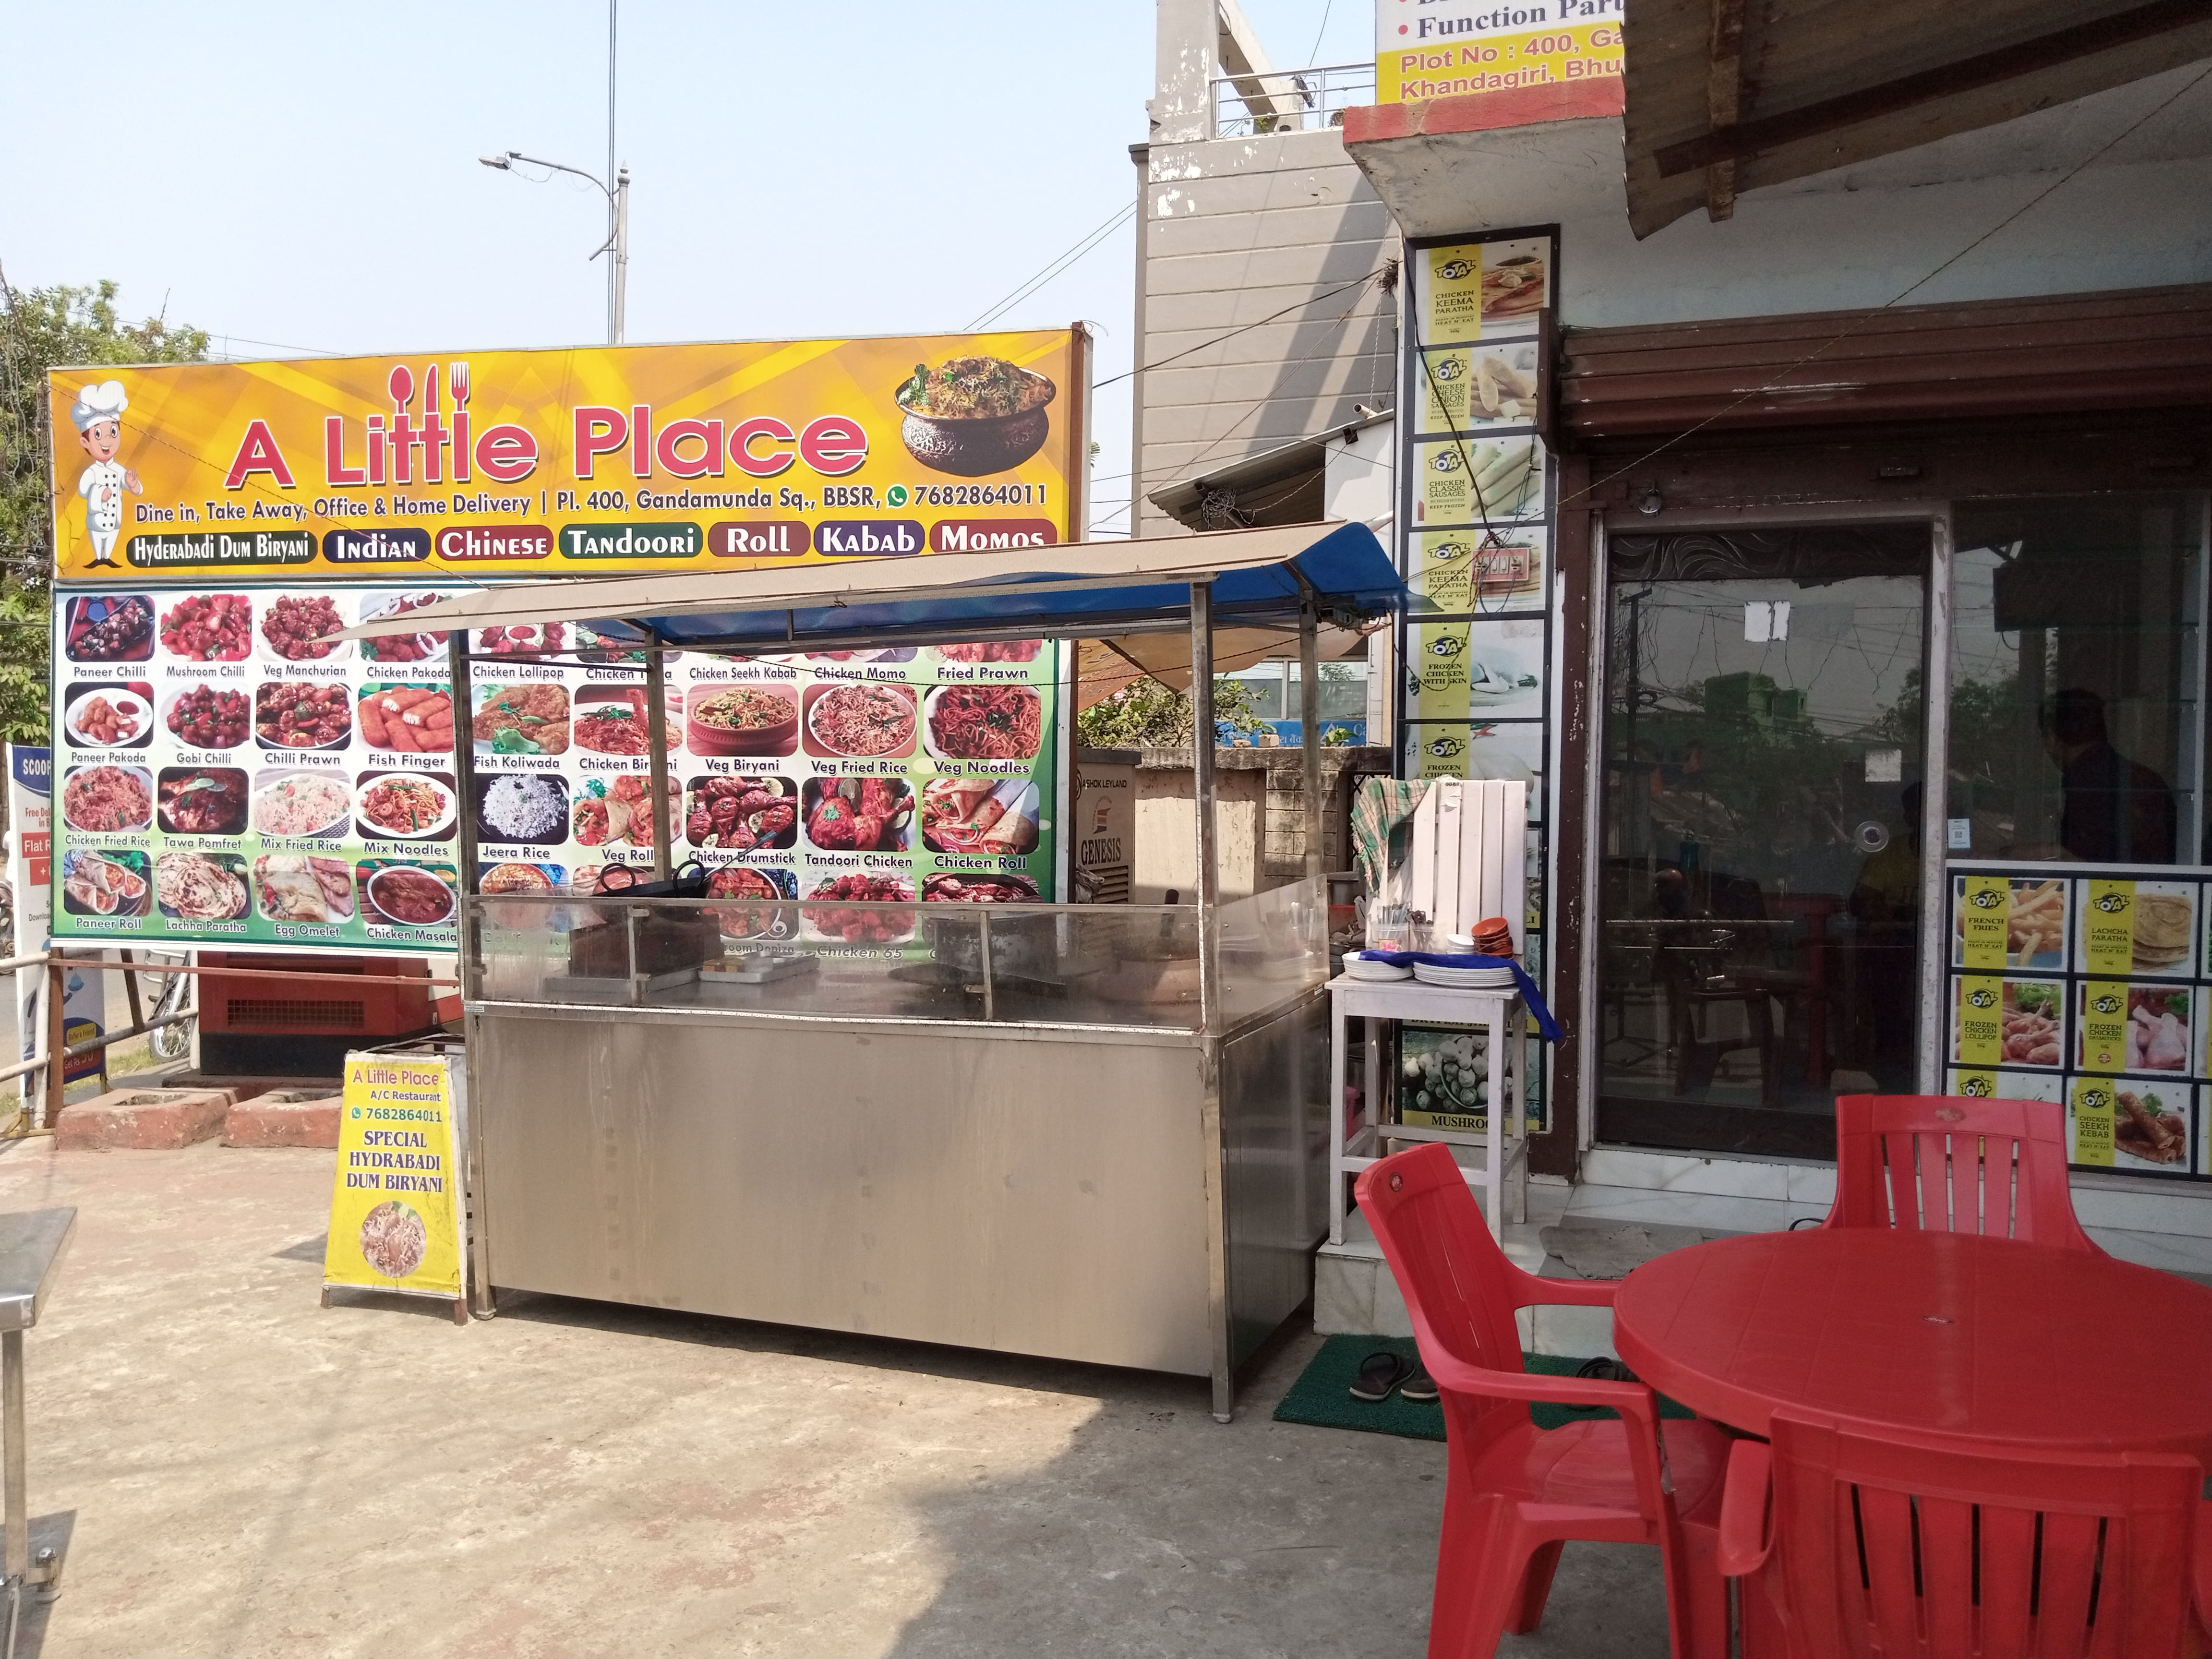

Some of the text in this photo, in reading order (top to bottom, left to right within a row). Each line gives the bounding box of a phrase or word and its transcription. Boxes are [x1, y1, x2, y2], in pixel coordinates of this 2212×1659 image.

[1417, 7, 1547, 38] Function
[1401, 50, 1452, 73] Plot
[1462, 47, 1498, 64] No
[1524, 34, 1580, 56] 400,
[1401, 58, 1621, 100] Khandagiri, Bhu
[1435, 259, 1476, 280] TOTAL
[1436, 290, 1474, 299] CHICKEN
[1436, 297, 1473, 307] KEEMA
[1436, 305, 1473, 314] PARATHA
[1431, 358, 1467, 382] TOTAL
[1431, 395, 1465, 404] ONION
[225, 404, 868, 489] A Little Place
[1429, 449, 1466, 473] TOTAL
[135, 503, 175, 524] Dine
[180, 501, 202, 523] in,
[206, 499, 246, 521] Take
[252, 498, 309, 521] Away,
[314, 495, 368, 517] Office
[373, 497, 387, 516] &
[392, 495, 447, 515] Home
[453, 493, 531, 517] Delivery
[557, 491, 581, 511] Pl.
[586, 490, 631, 513] 400,
[636, 486, 771, 510] Gandamunda
[780, 487, 817, 514] Sq.,
[823, 486, 882, 511] BBSR,
[914, 484, 1047, 506] 7682864011
[726, 527, 791, 553] Roll
[1428, 542, 1471, 560] TOTAL
[1426, 636, 1467, 657] TOTAL
[74, 666, 146, 677] Paneer Chilli
[167, 666, 245, 677] Mushroom Chilli
[264, 665, 346, 677] Veg Manchurian
[367, 667, 451, 678] Chicken Pakoda
[473, 666, 565, 680] Chicken Lollipop
[586, 668, 634, 679] Chicken
[689, 667, 796, 679] Chicken Seekh Kabab
[815, 667, 906, 679] Chicken Momo
[938, 668, 1028, 679] Fried Prawn
[1424, 736, 1465, 758] TOTAL
[72, 752, 146, 763] Paneer Pakoda
[177, 753, 231, 763] Gobi Chilli
[265, 753, 340, 765] Chilli Prawn
[369, 755, 445, 768] Fish Finger
[474, 756, 560, 768] Fish Koliwada
[579, 758, 627, 769] Chicken
[706, 759, 780, 773] Veg Biryani
[812, 761, 908, 774] Veg Fried Rice
[934, 761, 1030, 775] Veg Noodles
[1082, 779, 1127, 788] ASHOK LEYLAND
[25, 807, 39, 817] Free
[24, 840, 43, 852] Flat
[65, 835, 150, 846] Chicken Fried Rice
[164, 837, 241, 848] Tawa Pomfret
[261, 839, 341, 851] Mix Fried Rice
[364, 842, 448, 855] Mix Noodles
[483, 847, 550, 858] Jeera Rice
[1081, 838, 1121, 865] GENESIS
[602, 849, 654, 862] Veg Roll
[689, 851, 795, 864] Chicken Drumstick
[805, 854, 912, 867] Tandoori Chicken
[934, 855, 1027, 869] Chicken Roll
[1970, 889, 2005, 909] TOTAL
[2093, 892, 2130, 914] TOTAL
[76, 918, 142, 929] Paneer Roll
[166, 920, 247, 932] Lachha Paratha
[275, 924, 339, 937] Egg Omelet
[367, 927, 457, 941] Chicken Masala
[817, 945, 903, 959] Chicken 65
[1966, 989, 1998, 1009] TOTAL
[2091, 994, 2123, 1014] TOTAL
[353, 1070, 439, 1085] A Little Place
[1960, 1076, 1992, 1097] TOTAL
[371, 1090, 441, 1102] A/C Restaurant
[2080, 1088, 2110, 1108] TOTAL
[366, 1108, 442, 1122] 7682864011
[2080, 1122, 2109, 1130] SEEKH
[364, 1131, 428, 1148] SPECIAL
[349, 1152, 440, 1170] HYDRABADI
[347, 1173, 442, 1192] DUM BIRYANI
